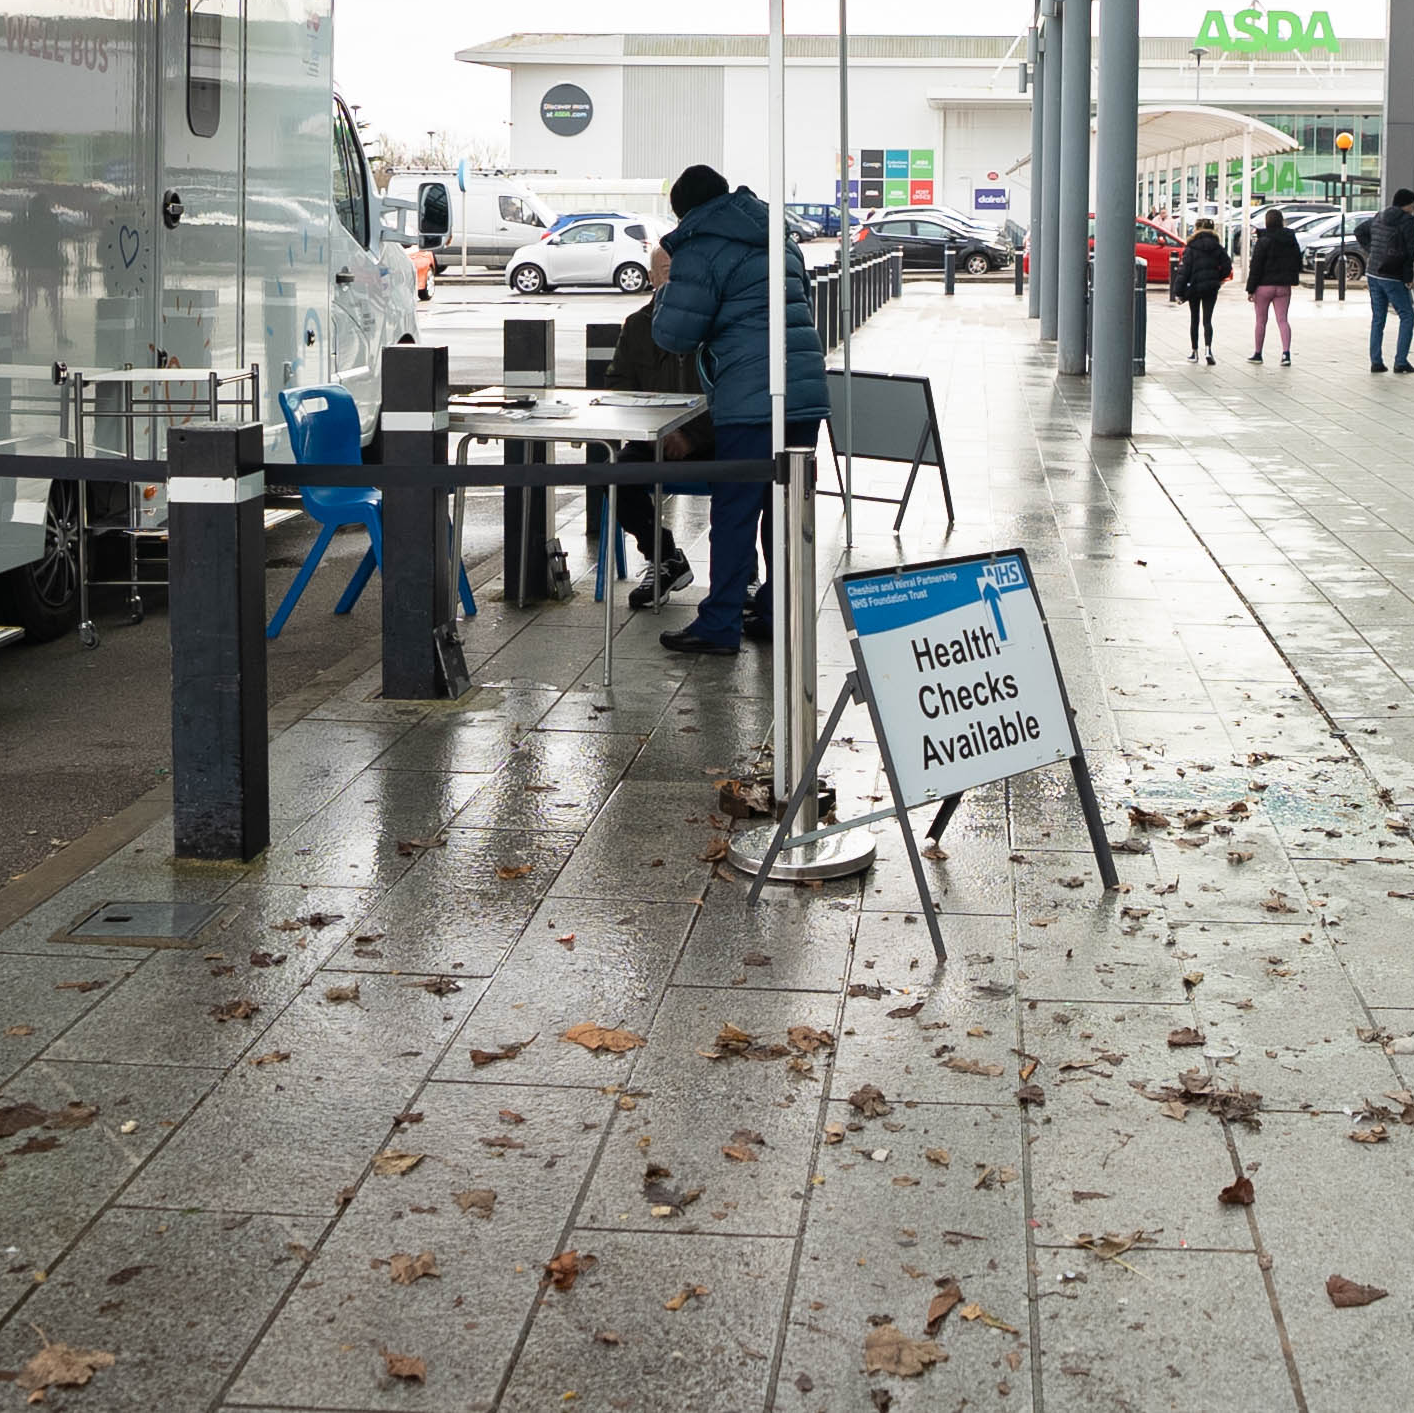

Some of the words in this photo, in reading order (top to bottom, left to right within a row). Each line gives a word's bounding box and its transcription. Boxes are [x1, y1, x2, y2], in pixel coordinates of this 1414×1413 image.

[3, 12, 65, 63] WELL
[70, 31, 108, 73] BUS
[1194, 9, 1340, 53] ASDA
[847, 581, 880, 597] Cheshire
[880, 579, 895, 592] and
[894, 576, 917, 590] Wirral
[917, 571, 958, 587] Partnership
[851, 598, 868, 611] NHS
[868, 592, 908, 608] Foundation
[908, 589, 928, 601] Trust
[911, 626, 1001, 673] Health
[919, 671, 1019, 719] Checks
[923, 711, 1041, 770] Available
